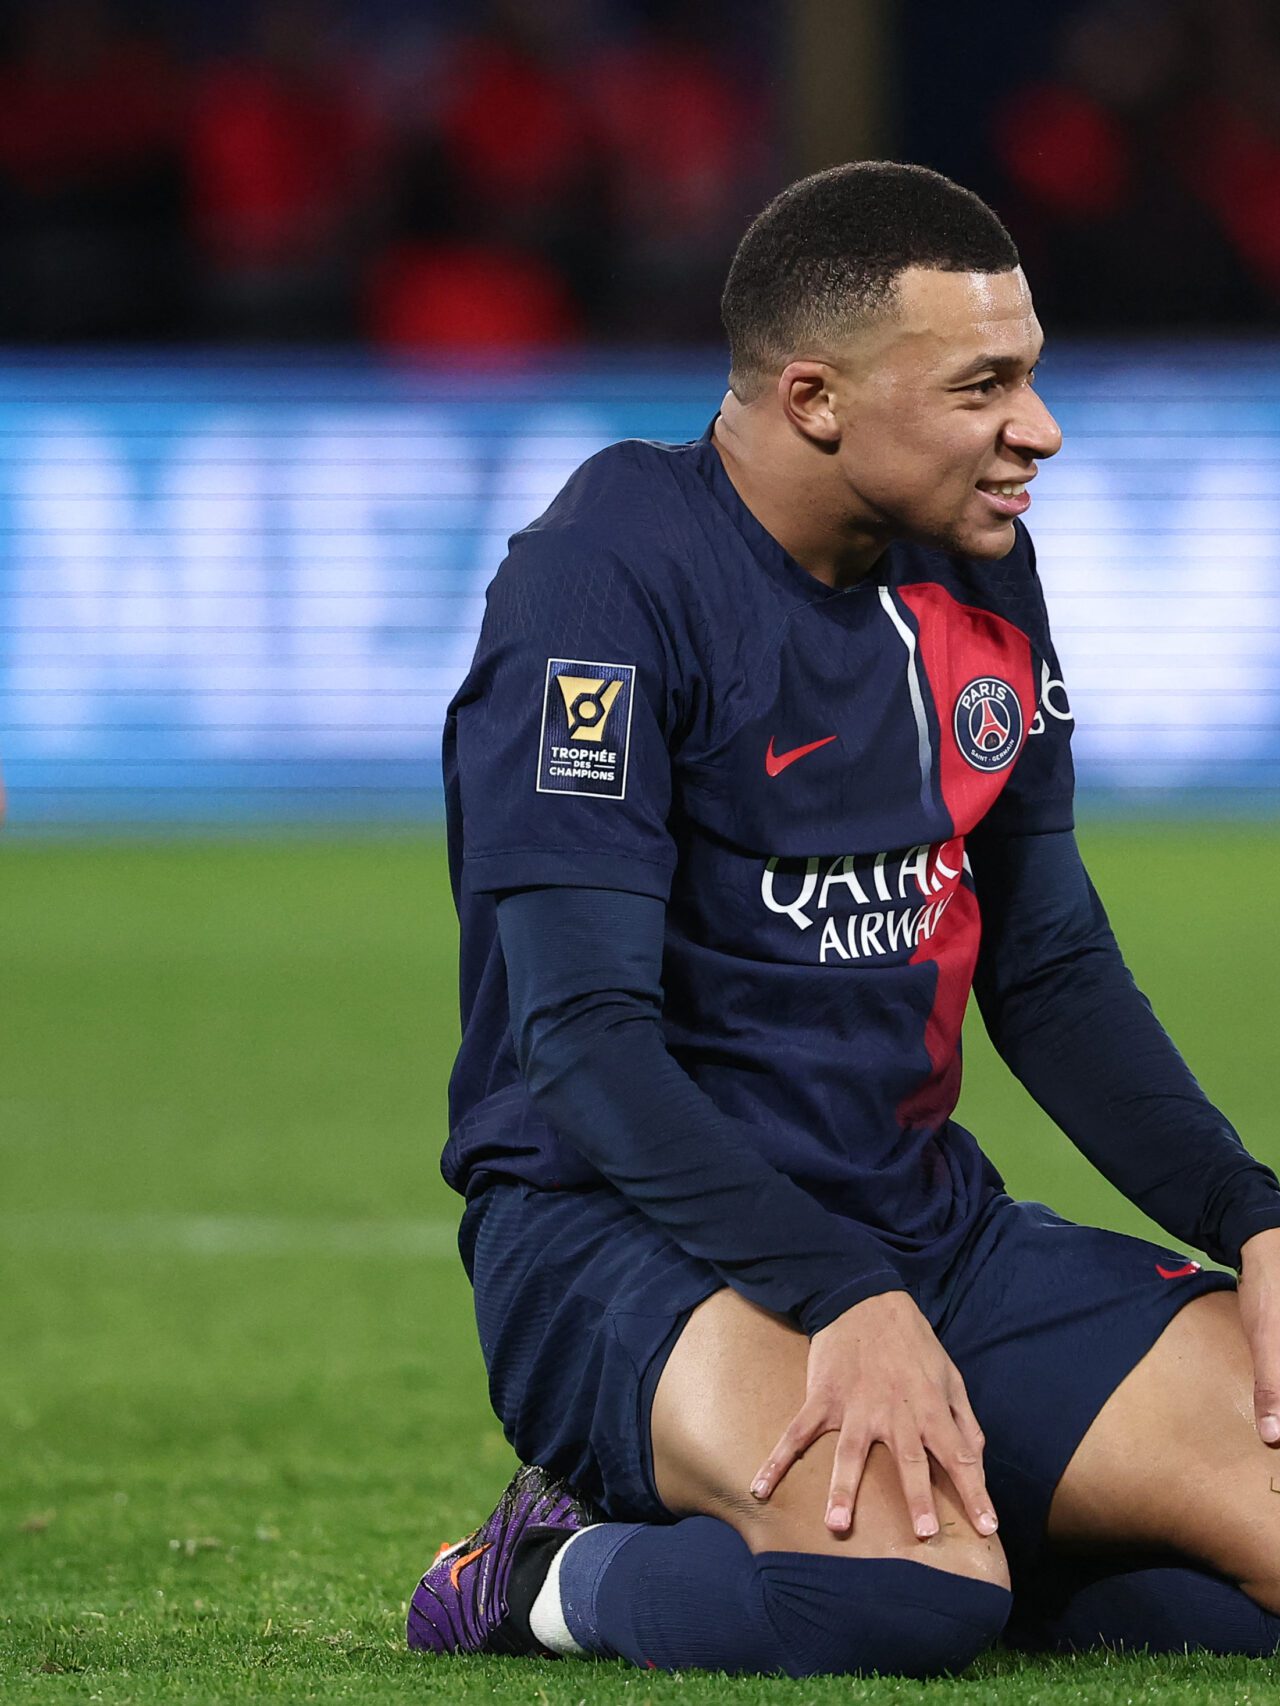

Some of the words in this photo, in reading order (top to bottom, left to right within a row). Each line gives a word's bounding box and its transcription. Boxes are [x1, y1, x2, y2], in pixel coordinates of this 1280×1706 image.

[961, 682, 1008, 710] PARIS
[551, 746, 617, 763] TROPHÉE
[573, 760, 592, 769] DES
[549, 766, 615, 781] CHAMPIONS
